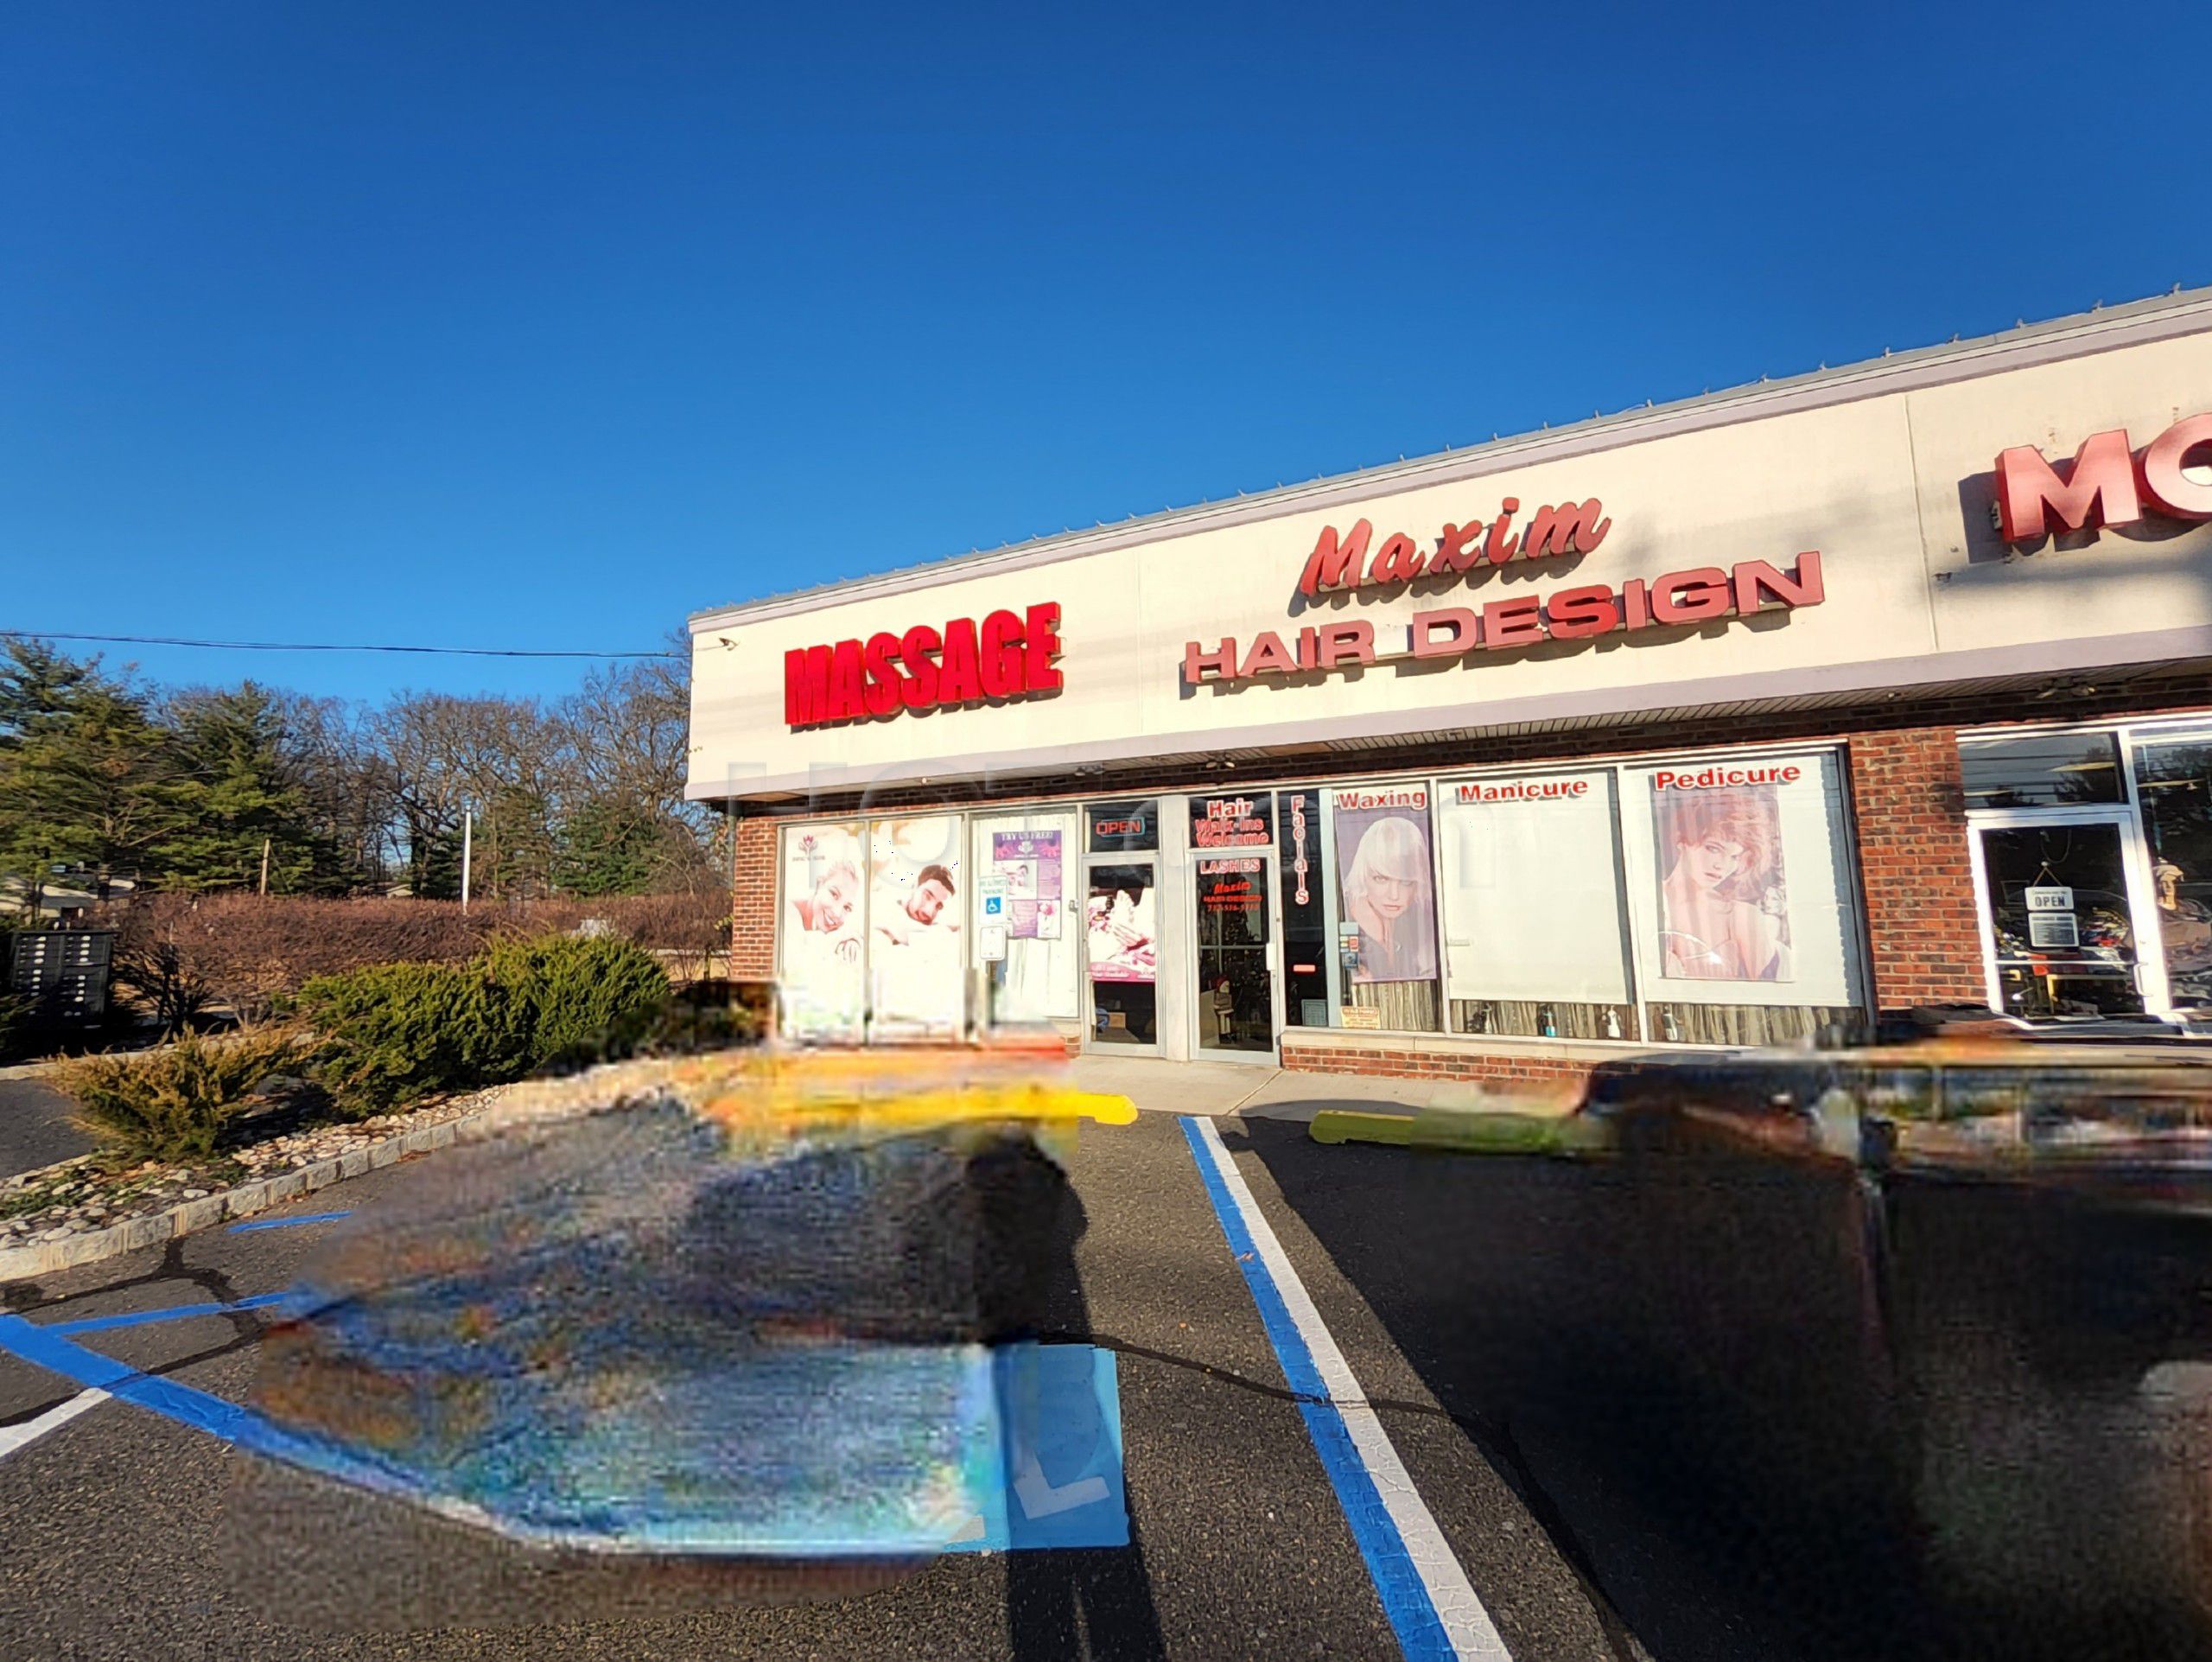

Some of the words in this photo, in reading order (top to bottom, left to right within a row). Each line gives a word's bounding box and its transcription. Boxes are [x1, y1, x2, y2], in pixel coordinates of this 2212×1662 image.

[1299, 496, 1612, 597] Maxim
[1185, 619, 1375, 685] HAIR
[1412, 551, 1825, 659] DESIGN
[785, 602, 1064, 725] MASSAGE
[1655, 761, 1802, 791] Pedicure
[1337, 787, 1427, 812] Waxing
[1458, 777, 1590, 804] Manicure
[1207, 798, 1254, 818] Hair
[1096, 819, 1141, 836] OPEN
[1196, 831, 1269, 847] Welcome
[1200, 858, 1261, 874] LASHES
[2035, 896, 2065, 907] OPEN
